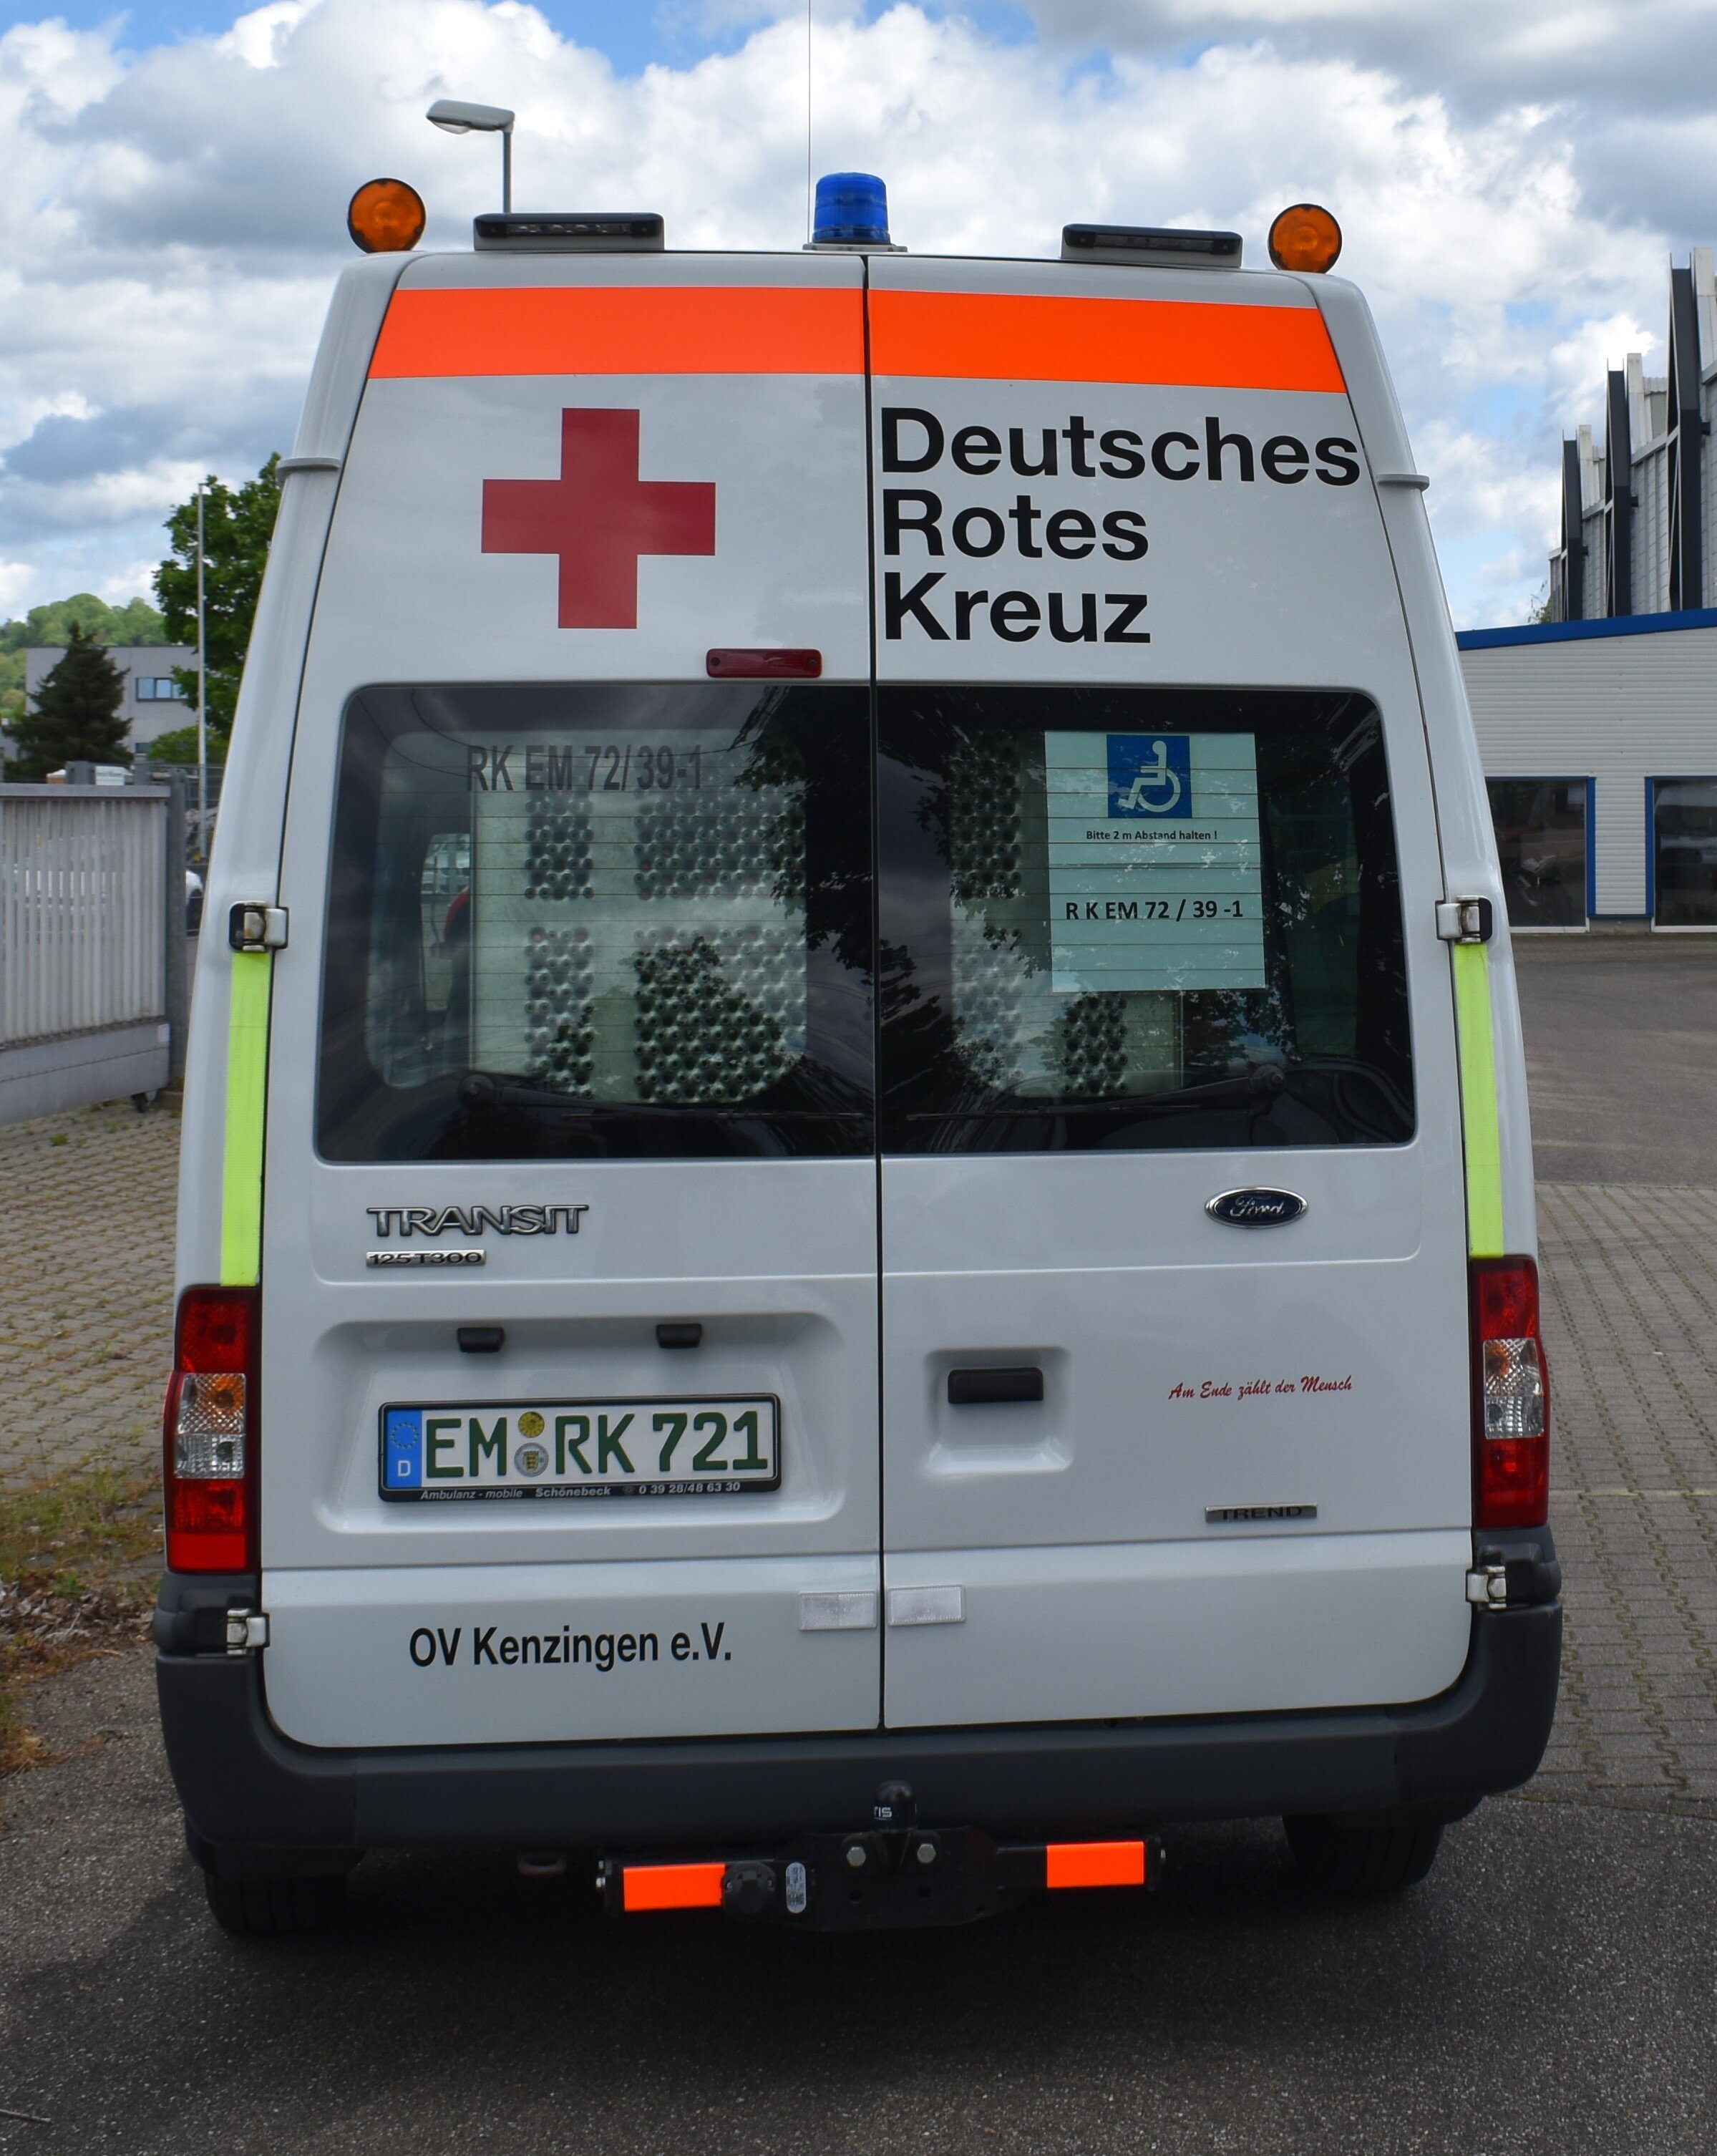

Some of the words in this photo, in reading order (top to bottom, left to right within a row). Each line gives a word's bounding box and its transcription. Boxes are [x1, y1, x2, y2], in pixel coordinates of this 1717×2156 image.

[881, 407, 1361, 486] Deutsches
[882, 488, 1149, 561] Rotes
[884, 572, 1151, 644] Kreuz
[467, 744, 514, 791] RK
[525, 744, 573, 791] EM
[1086, 830, 1110, 840] Bitte
[1113, 830, 1120, 840] 2
[1134, 830, 1176, 840] Abstand
[1179, 830, 1211, 840] halten
[1230, 1195, 1285, 1217] Ford
[366, 1205, 589, 1237] TRANSIT
[369, 1252, 482, 1264] 125T300
[1168, 1382, 1195, 1400] Am
[1200, 1380, 1232, 1399] Ende
[1237, 1379, 1271, 1401] zählt
[1275, 1379, 1295, 1393] der
[1300, 1374, 1353, 1393] Mensch
[426, 1417, 507, 1478] EM
[555, 1413, 636, 1475] RK
[652, 1410, 768, 1472] 721
[397, 1460, 411, 1477] D
[420, 1489, 476, 1500] Ambulanz
[485, 1487, 523, 1499] mobile
[535, 1485, 611, 1497] Schönebeck
[725, 1482, 741, 1492] 30
[1222, 1506, 1303, 1520] TREND
[409, 1627, 462, 1667] OV
[473, 1625, 658, 1672] Kenzingen
[671, 1621, 732, 1662] e.V.
